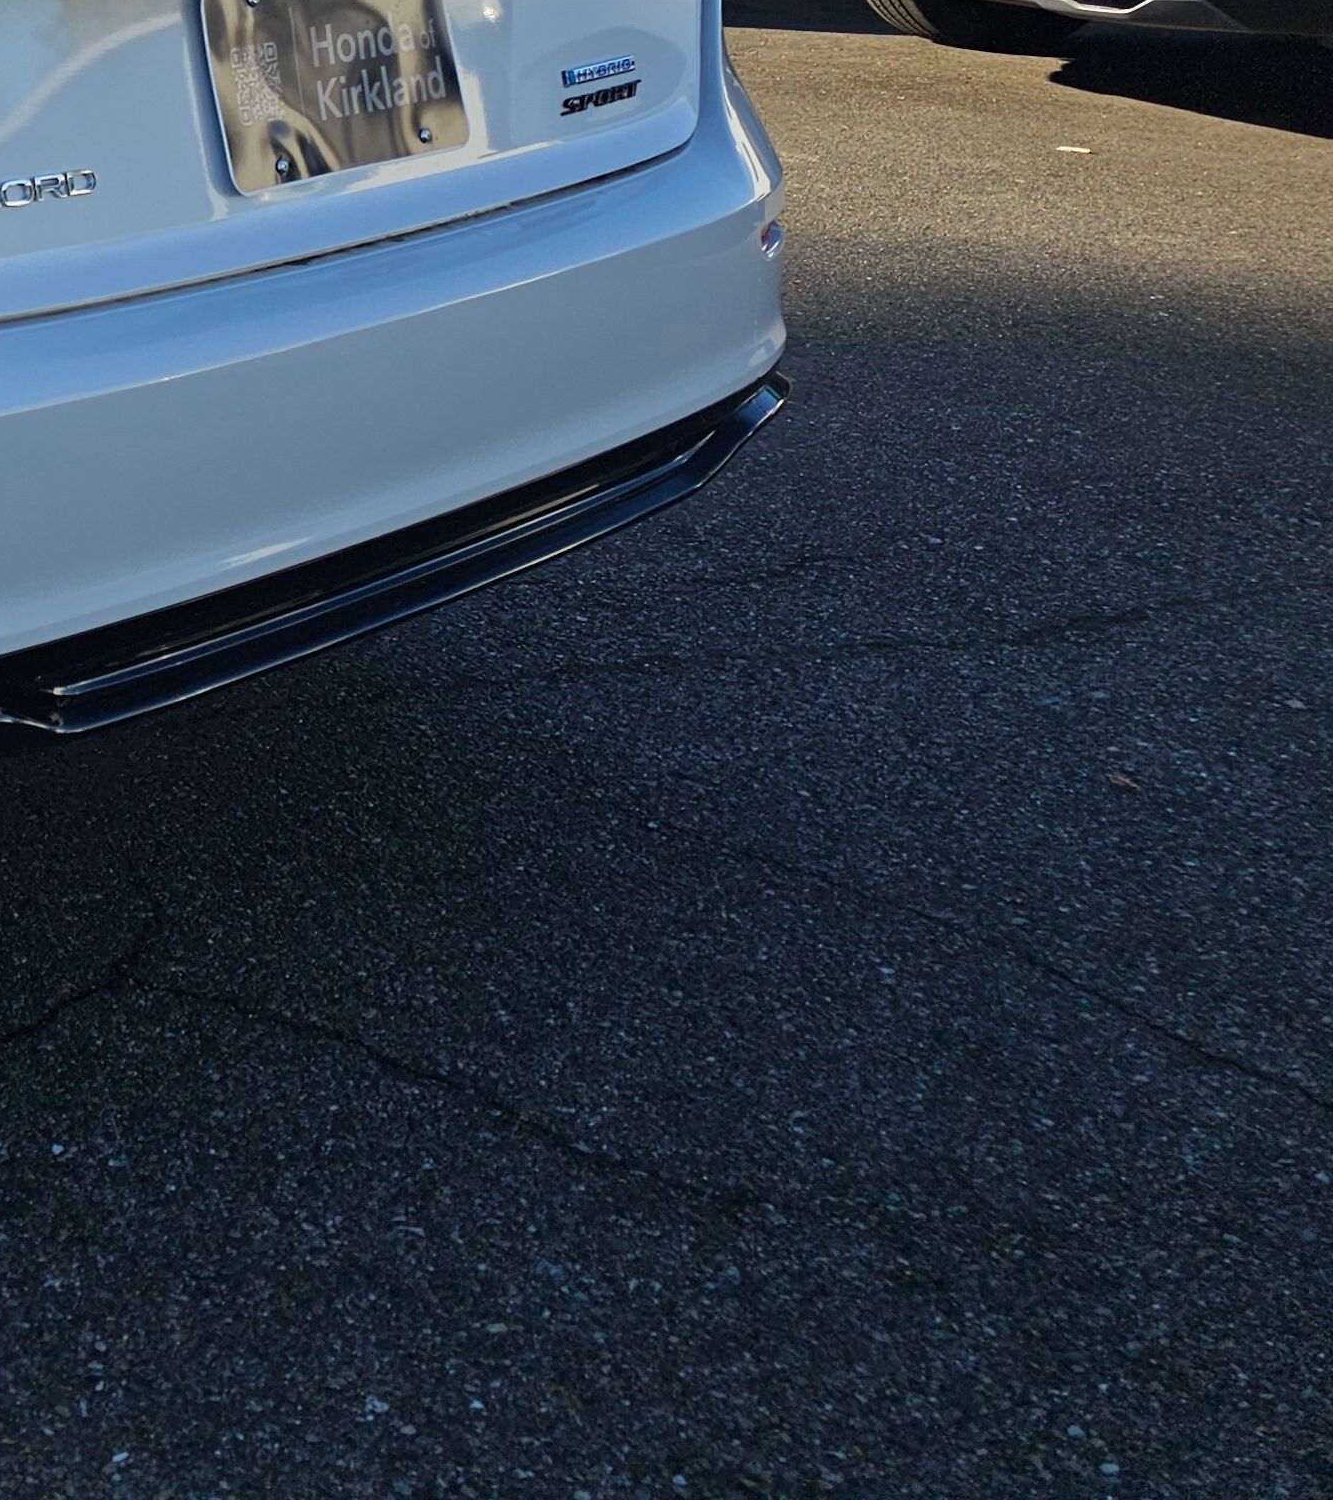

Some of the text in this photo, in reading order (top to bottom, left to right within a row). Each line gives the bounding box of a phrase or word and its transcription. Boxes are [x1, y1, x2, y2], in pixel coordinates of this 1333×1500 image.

[309, 12, 436, 68] Honda of
[316, 56, 447, 121] Kirkland
[560, 79, 642, 116] SPORT
